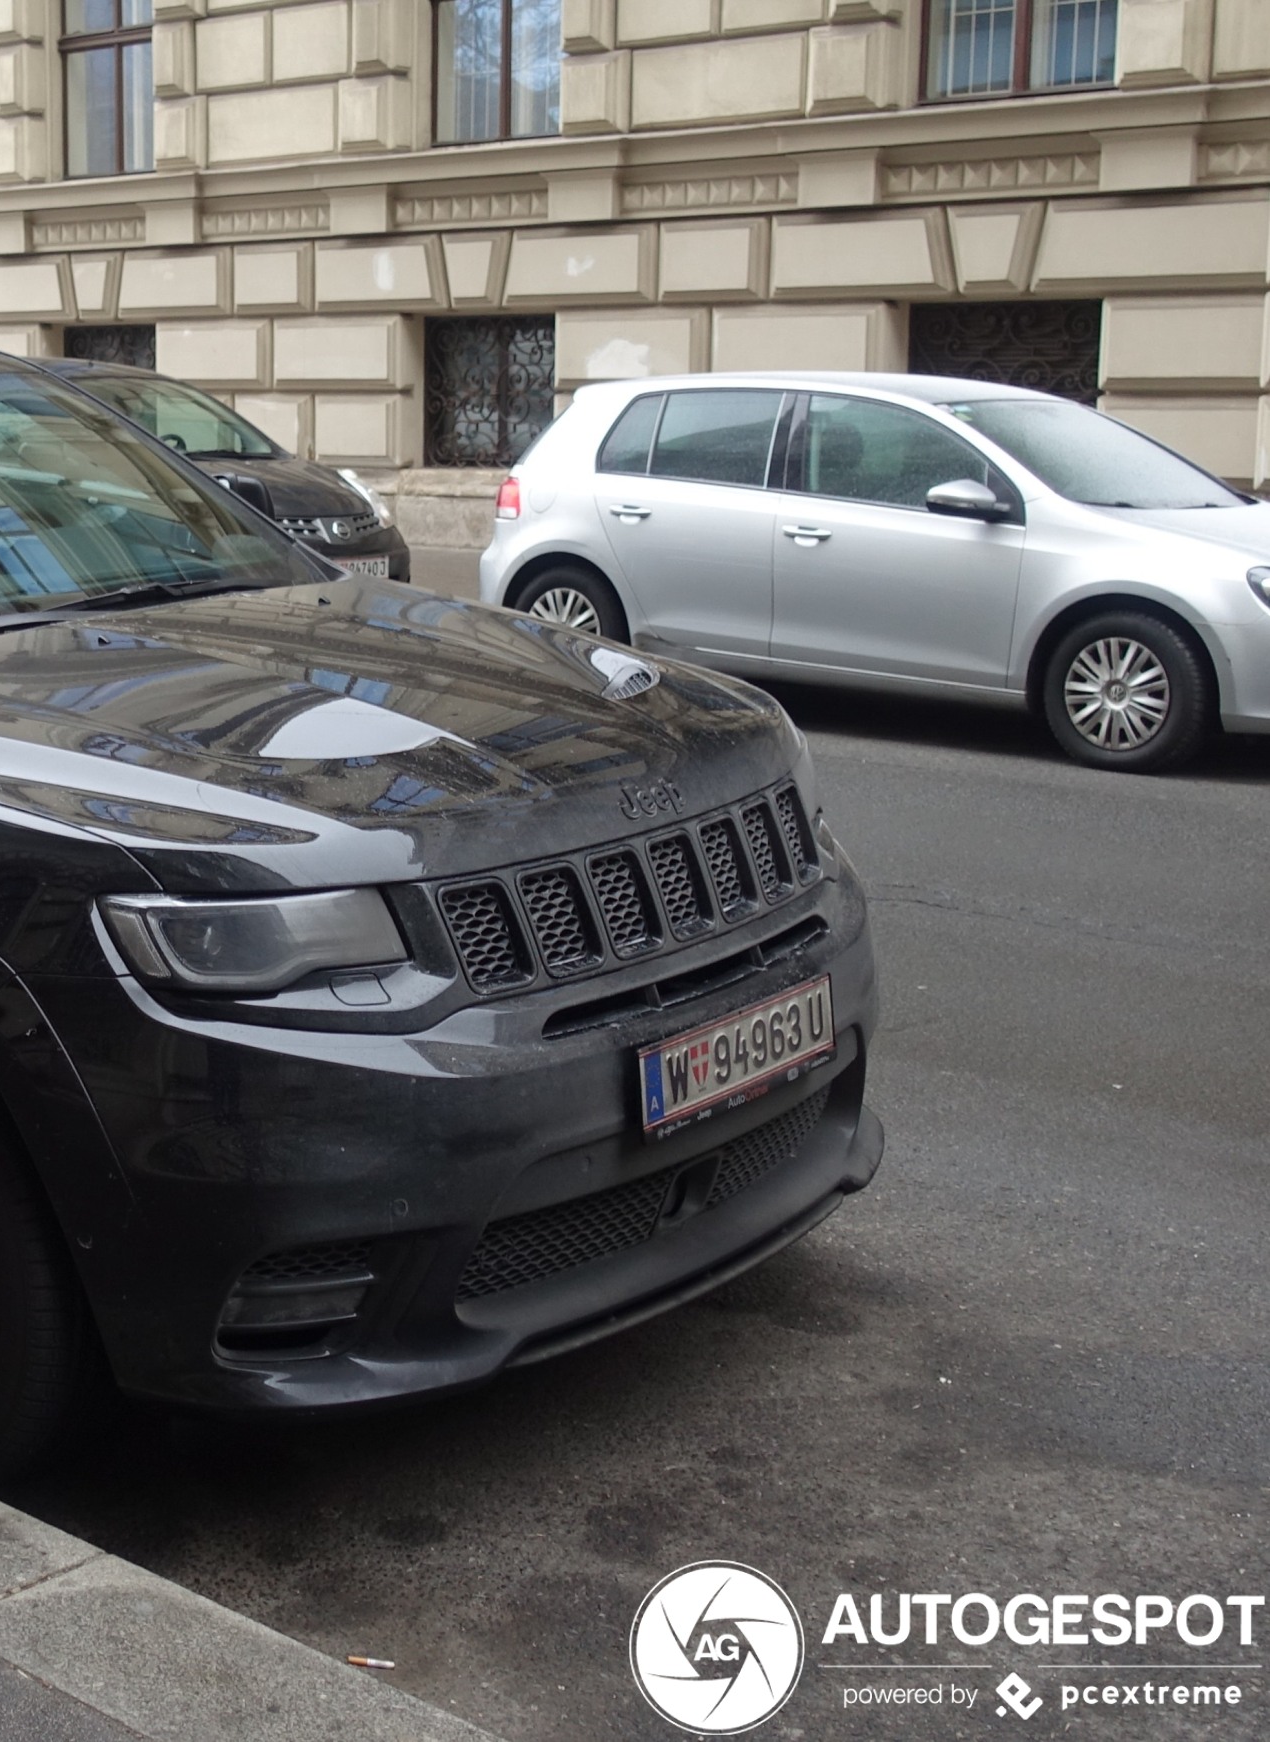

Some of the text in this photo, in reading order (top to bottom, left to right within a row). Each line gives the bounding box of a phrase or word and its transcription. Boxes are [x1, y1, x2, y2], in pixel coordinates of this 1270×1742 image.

[618, 779, 685, 820] Jeep
[666, 990, 823, 1105] W 94963 U
[650, 1094, 660, 1113] A
